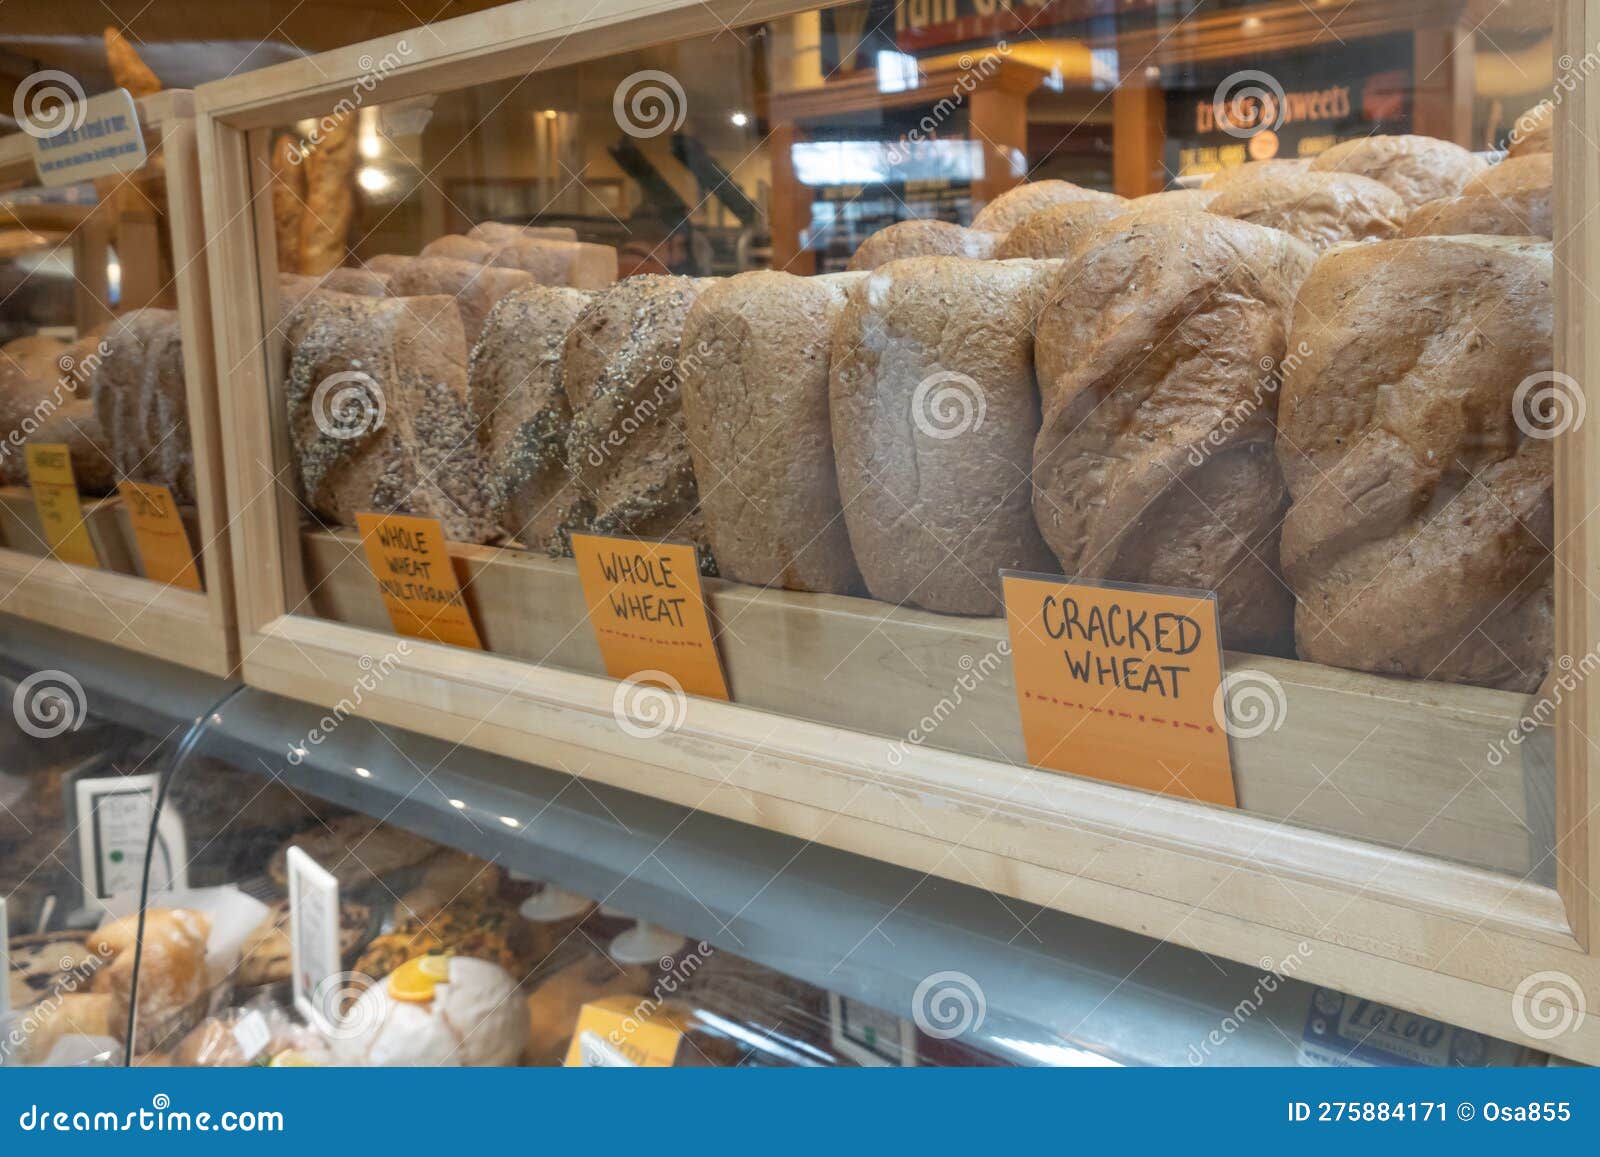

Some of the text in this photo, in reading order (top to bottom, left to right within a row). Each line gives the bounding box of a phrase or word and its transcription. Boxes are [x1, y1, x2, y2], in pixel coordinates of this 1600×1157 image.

[376, 524, 429, 554] WHOLE
[385, 557, 432, 580] WHEAT
[598, 551, 677, 588] WHOLE
[609, 592, 686, 627] WHEAT
[1042, 595, 1202, 655] CRACKED
[1064, 650, 1191, 698] WHEAT
